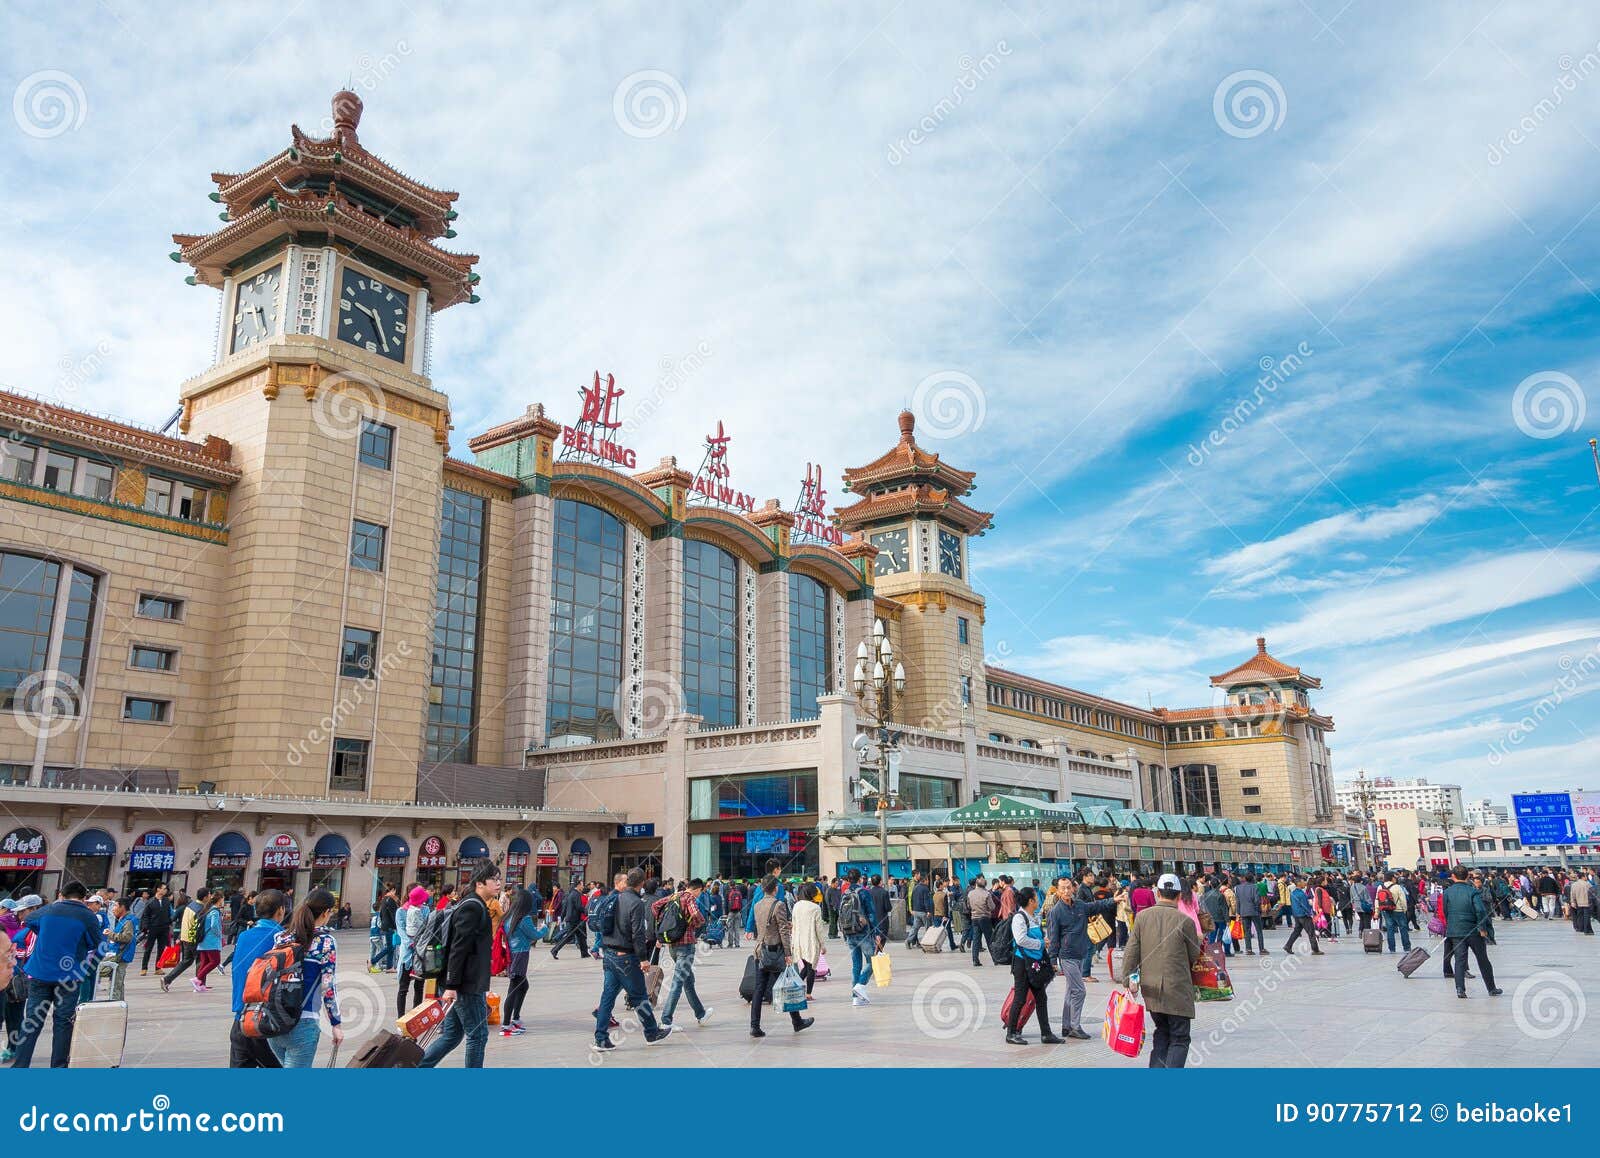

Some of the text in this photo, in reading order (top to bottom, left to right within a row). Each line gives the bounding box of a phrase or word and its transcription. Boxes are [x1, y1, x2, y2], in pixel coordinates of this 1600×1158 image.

[581, 370, 625, 429] 北
[563, 425, 636, 469] BEIJING
[792, 514, 843, 546] TATION
[133, 853, 174, 869] 站区寄存
